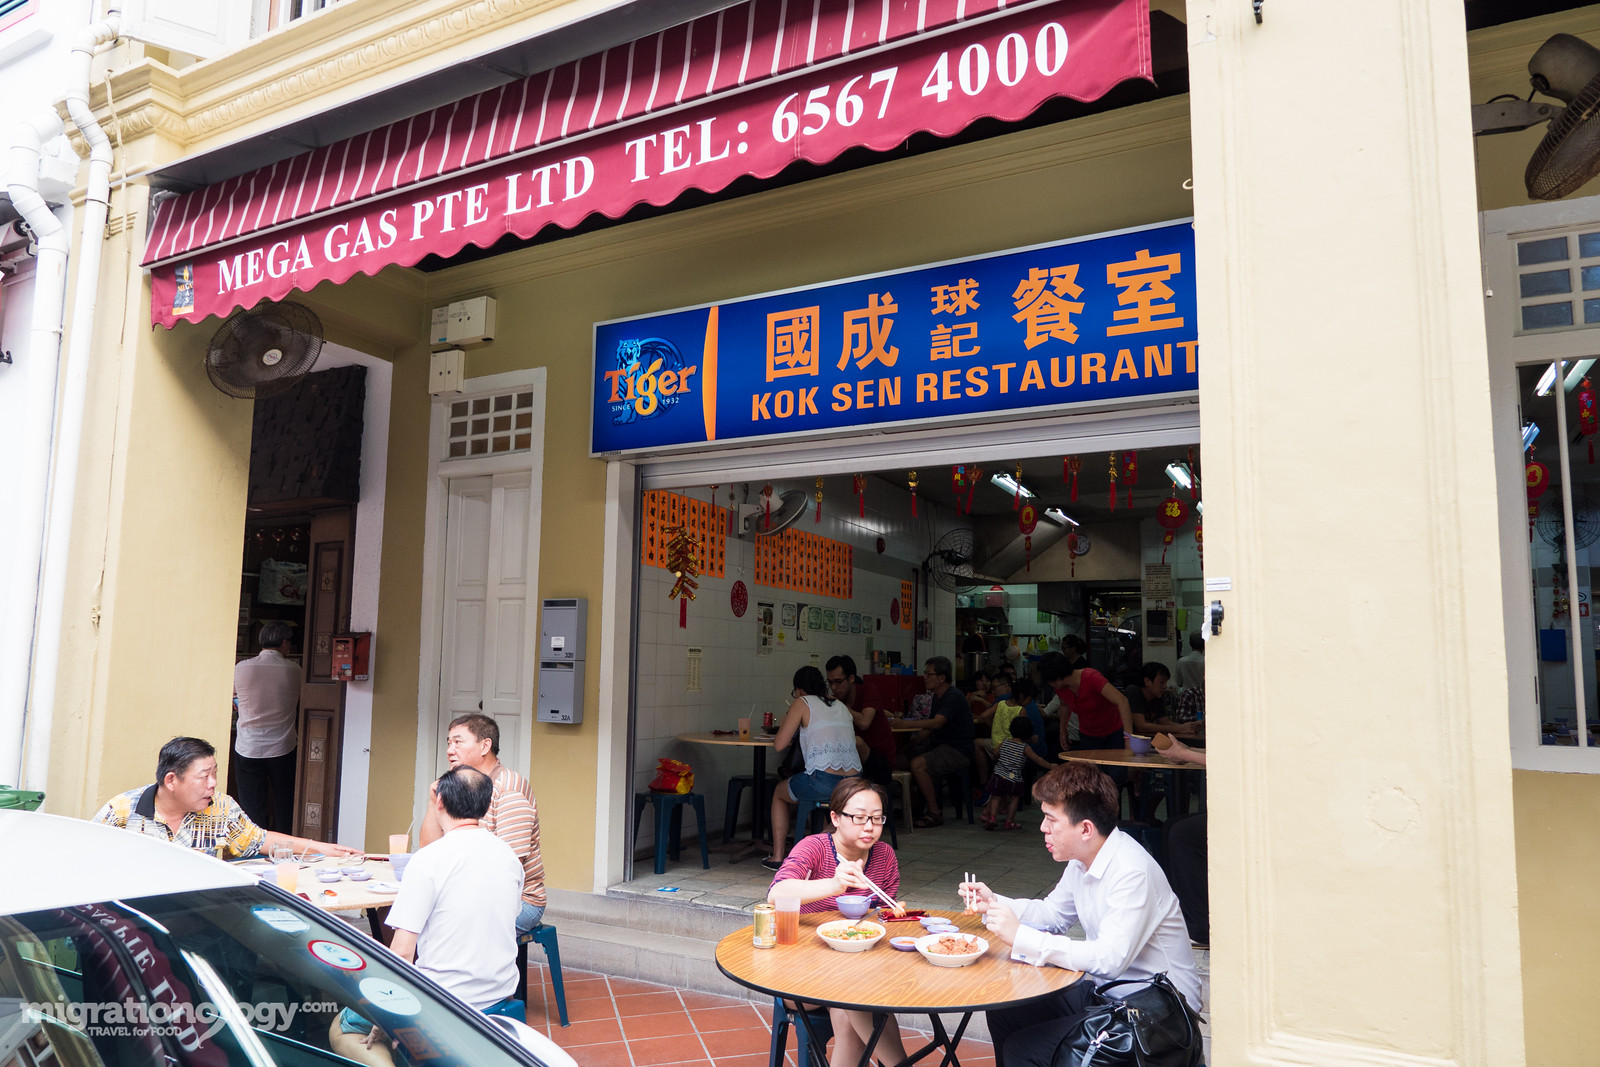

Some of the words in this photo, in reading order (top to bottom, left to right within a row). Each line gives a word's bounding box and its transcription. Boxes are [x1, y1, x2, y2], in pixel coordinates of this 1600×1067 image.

[217, 235, 313, 295] MEGA
[323, 208, 398, 263] GAS
[409, 183, 489, 242] PTE
[503, 155, 595, 216] LTD
[625, 117, 749, 183] TEL:
[771, 67, 899, 143] 6567
[921, 22, 1069, 103] 4000
[604, 358, 697, 416] Tiger
[611, 403, 631, 412] SINCE
[662, 397, 680, 405] 1932
[751, 386, 819, 421] KOK
[831, 376, 901, 412] SEN
[916, 340, 1199, 403] RESTAURANT
